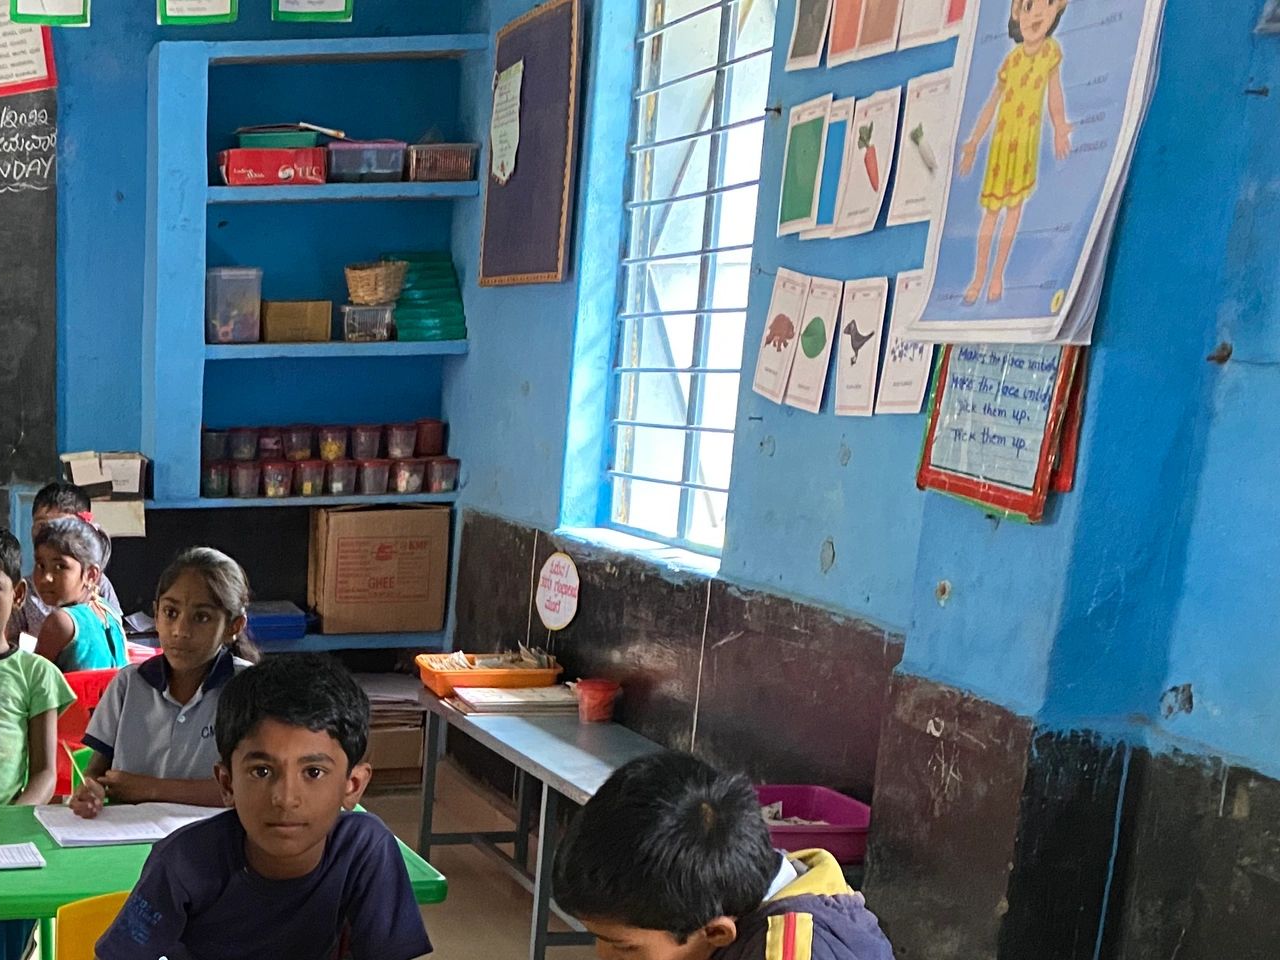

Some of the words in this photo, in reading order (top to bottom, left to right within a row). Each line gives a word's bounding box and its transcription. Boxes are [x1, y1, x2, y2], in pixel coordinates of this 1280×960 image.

[1001, 354, 1024, 373] pace
[982, 402, 1007, 418] them
[979, 426, 1006, 446] them
[368, 576, 395, 590] GHEE
